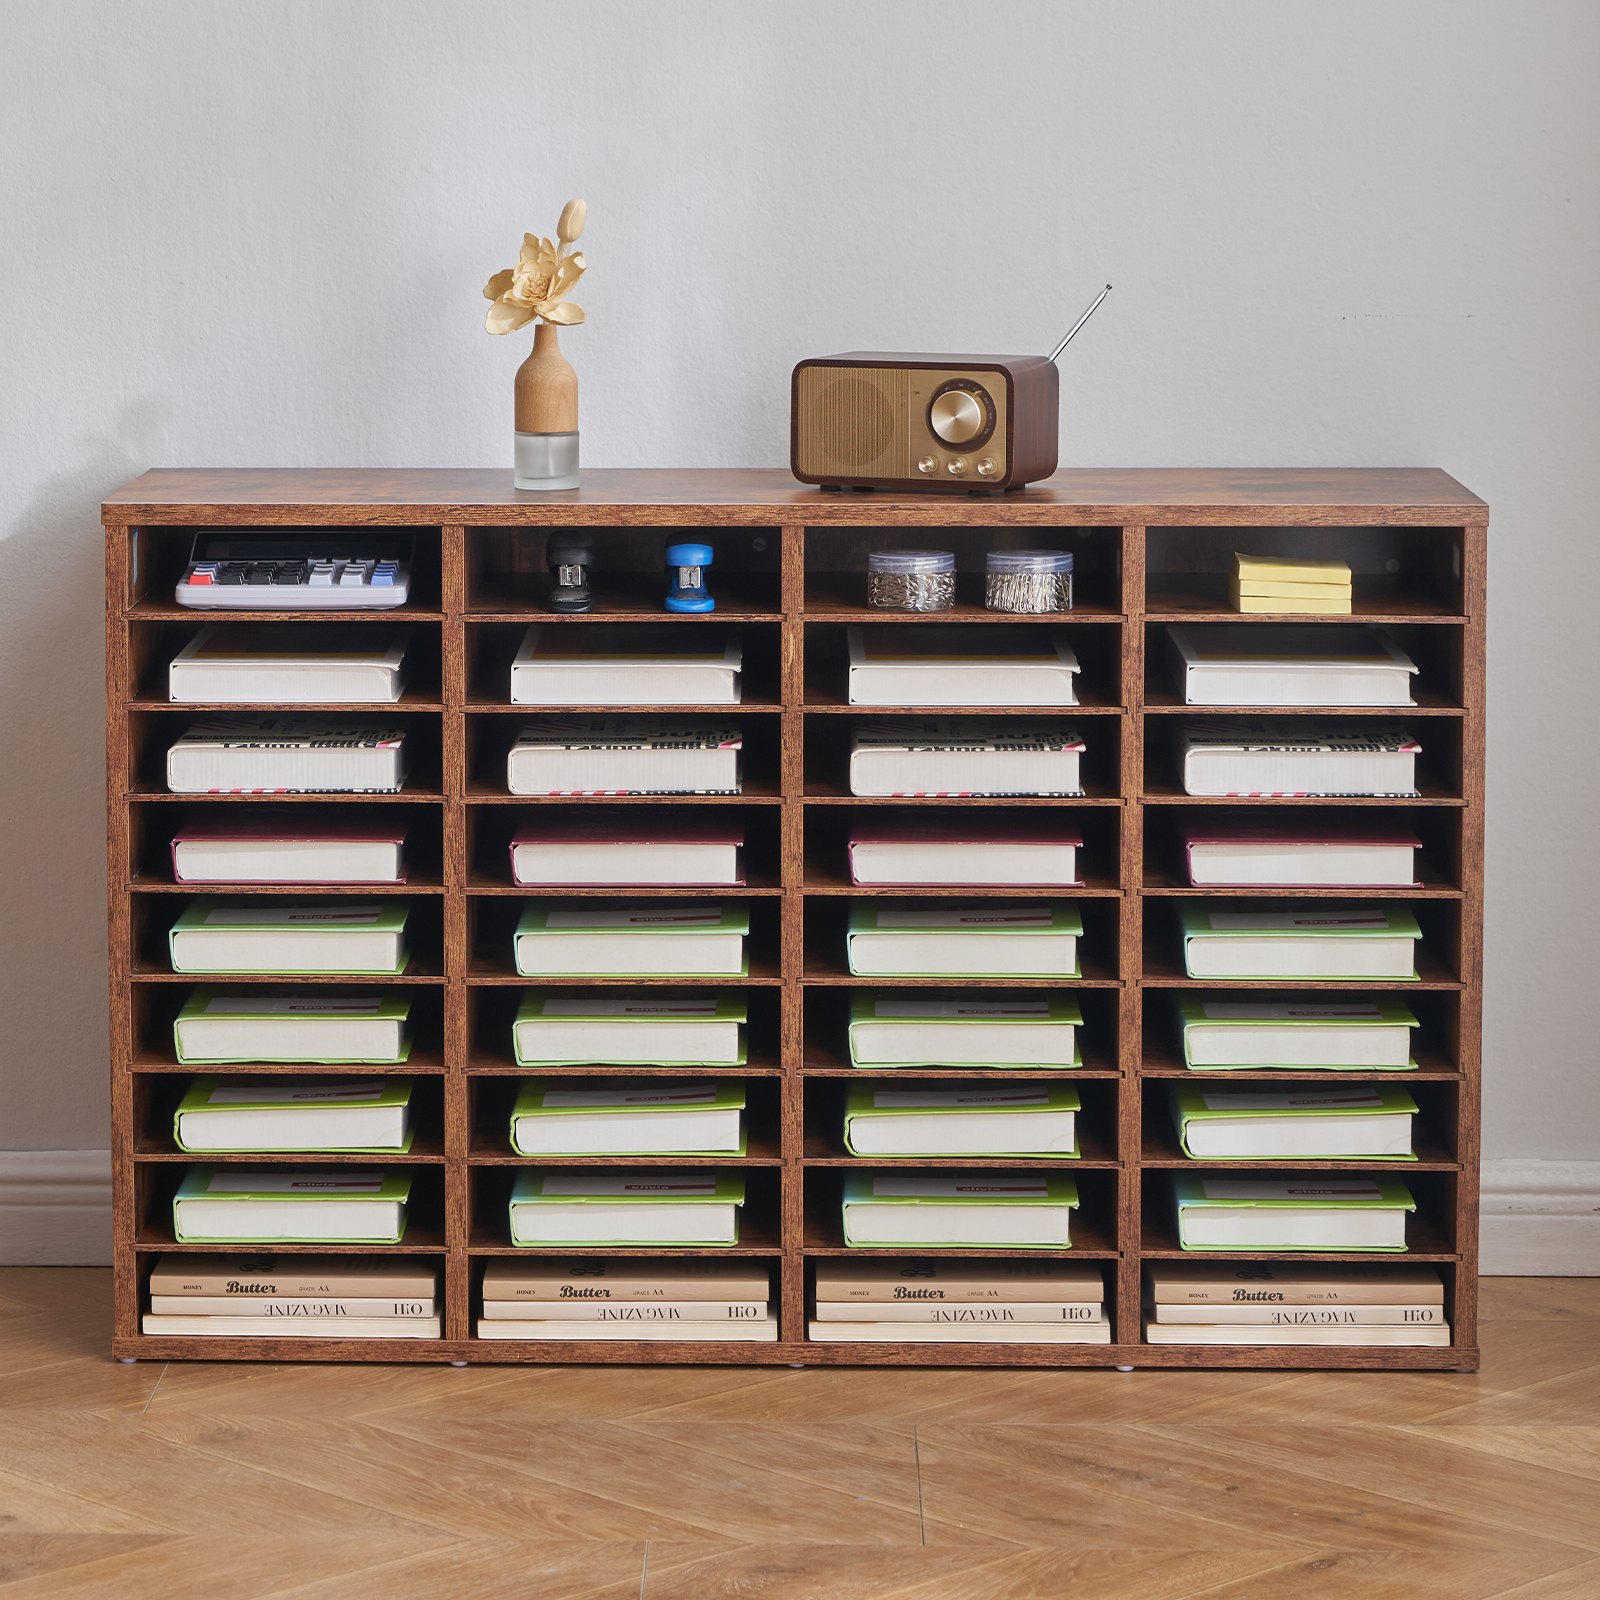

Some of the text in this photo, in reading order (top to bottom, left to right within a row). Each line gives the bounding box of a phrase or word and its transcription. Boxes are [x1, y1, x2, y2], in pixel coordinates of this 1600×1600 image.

[226, 1280, 278, 1294] Butter
[560, 1285, 612, 1298] Butter
[894, 1286, 945, 1299] Butter
[1232, 1288, 1285, 1302] Butter
[264, 1304, 346, 1316] MAGAZINE
[598, 1308, 681, 1320] MAGAZINE
[930, 1309, 1015, 1322] MAGAZINE
[1272, 1312, 1356, 1324] MAGAZINE
